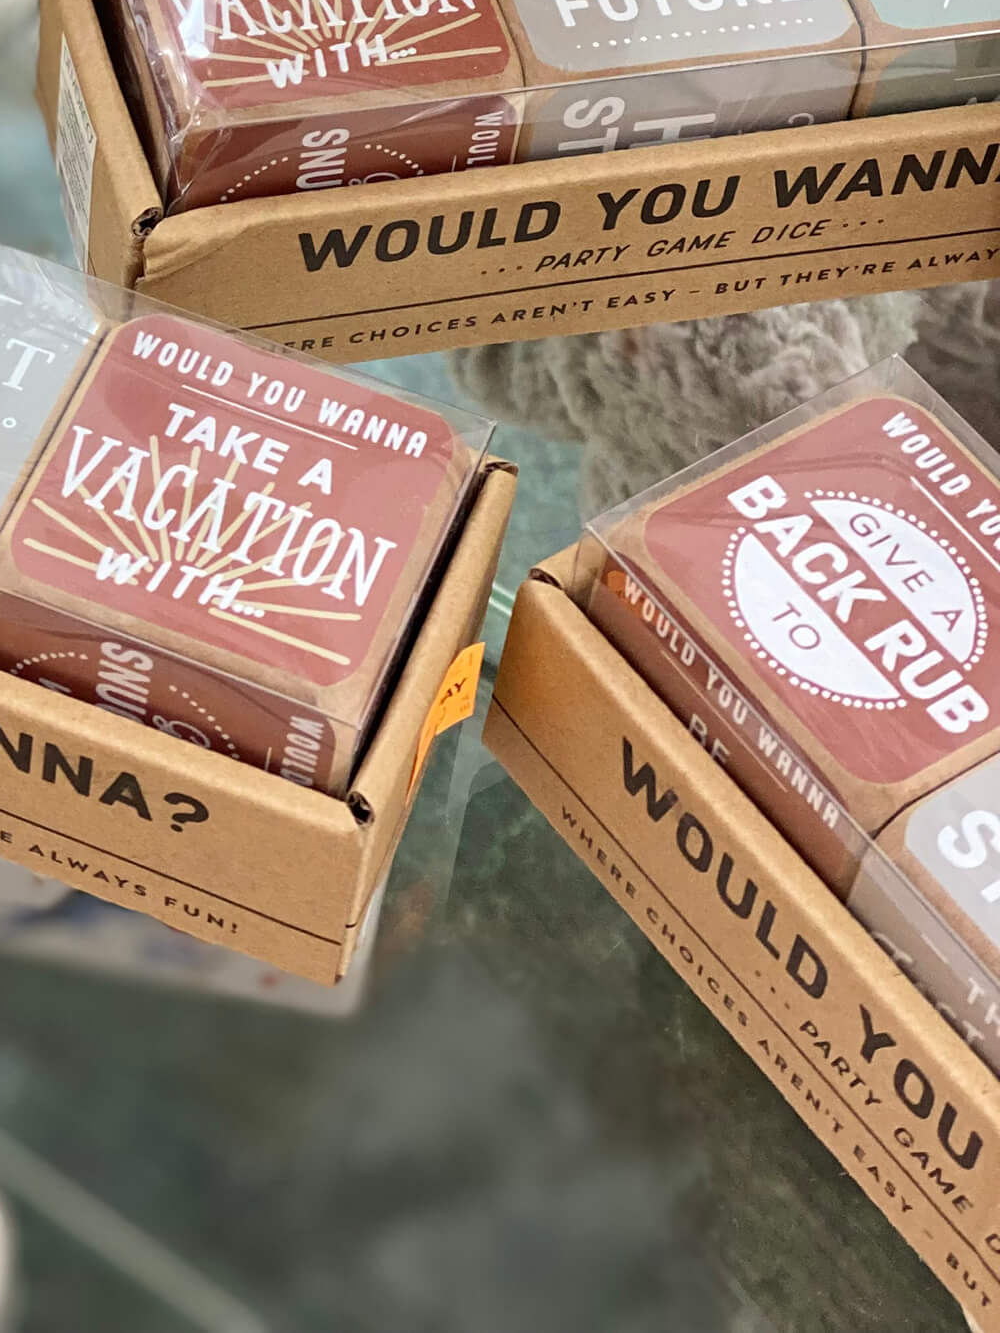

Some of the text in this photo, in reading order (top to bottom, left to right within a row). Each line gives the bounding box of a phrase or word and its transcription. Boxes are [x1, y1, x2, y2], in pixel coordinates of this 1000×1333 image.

[297, 175, 741, 274] WOULD YOU
[535, 218, 832, 275] PARTY GAME DICE
[349, 261, 897, 346] CHOICES AREN'T EASY BUT THEY'RE
[131, 330, 429, 458] WOULD YOU WANNA
[163, 403, 334, 494] TAKE A
[881, 411, 971, 497] WOULD
[60, 424, 397, 608] VACATION
[847, 513, 965, 634] GIVE A
[727, 474, 990, 735] BACK RUB
[770, 601, 822, 651] TO
[623, 576, 841, 830] WOULD YOU WANNA
[27, 844, 148, 898] ALWAYS
[163, 895, 241, 935] FUN!
[620, 735, 984, 1171] WOULD YOU
[561, 804, 992, 1308] WHERE CHOICES AREN'T EASY BUT
[799, 1020, 974, 1215] PARTY GAME
